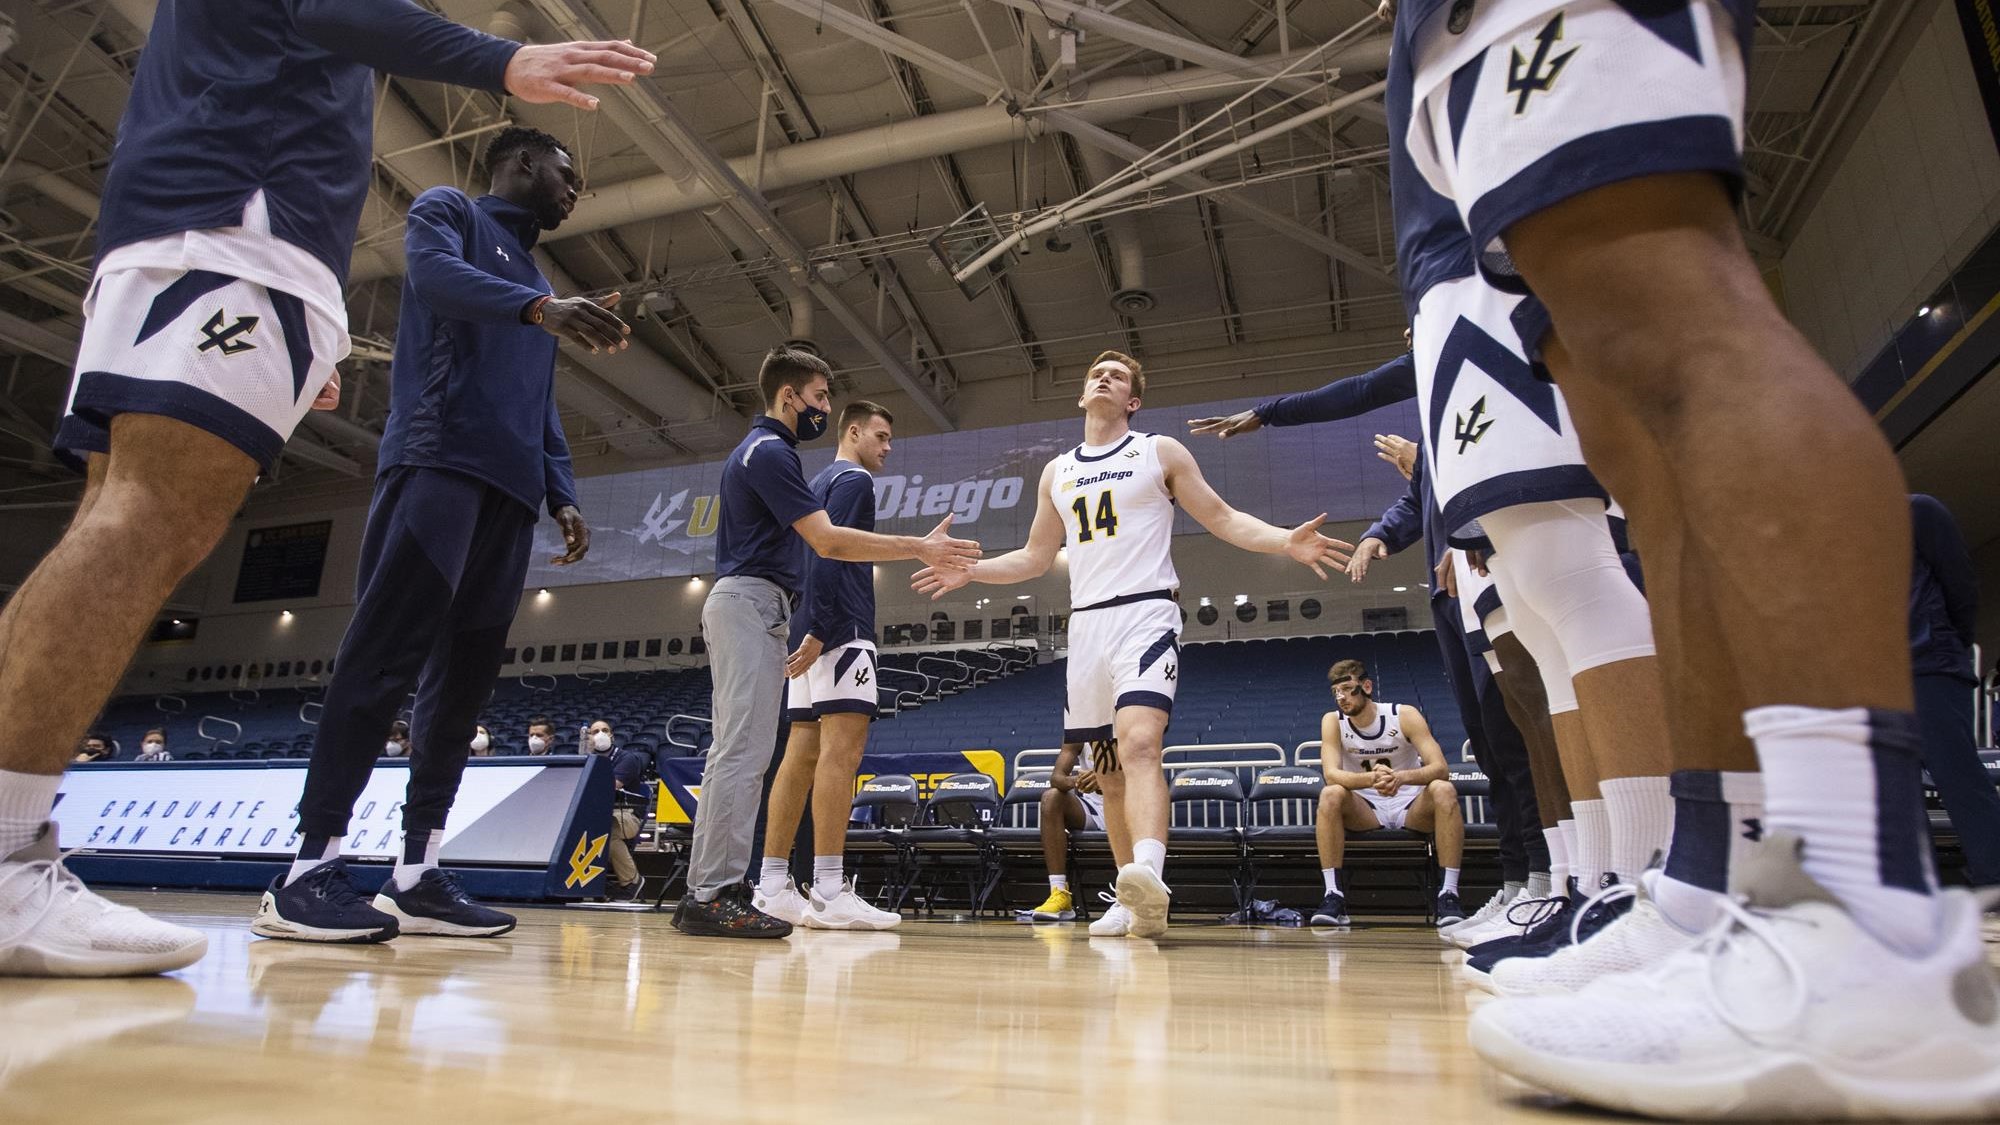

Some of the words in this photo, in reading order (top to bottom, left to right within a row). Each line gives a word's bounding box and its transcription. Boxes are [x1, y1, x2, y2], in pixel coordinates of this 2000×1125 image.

[872, 474, 1024, 525] Diego
[1072, 489, 1118, 544] 14
[100, 800, 264, 818] GRADUATE
[87, 825, 148, 844] SAN
